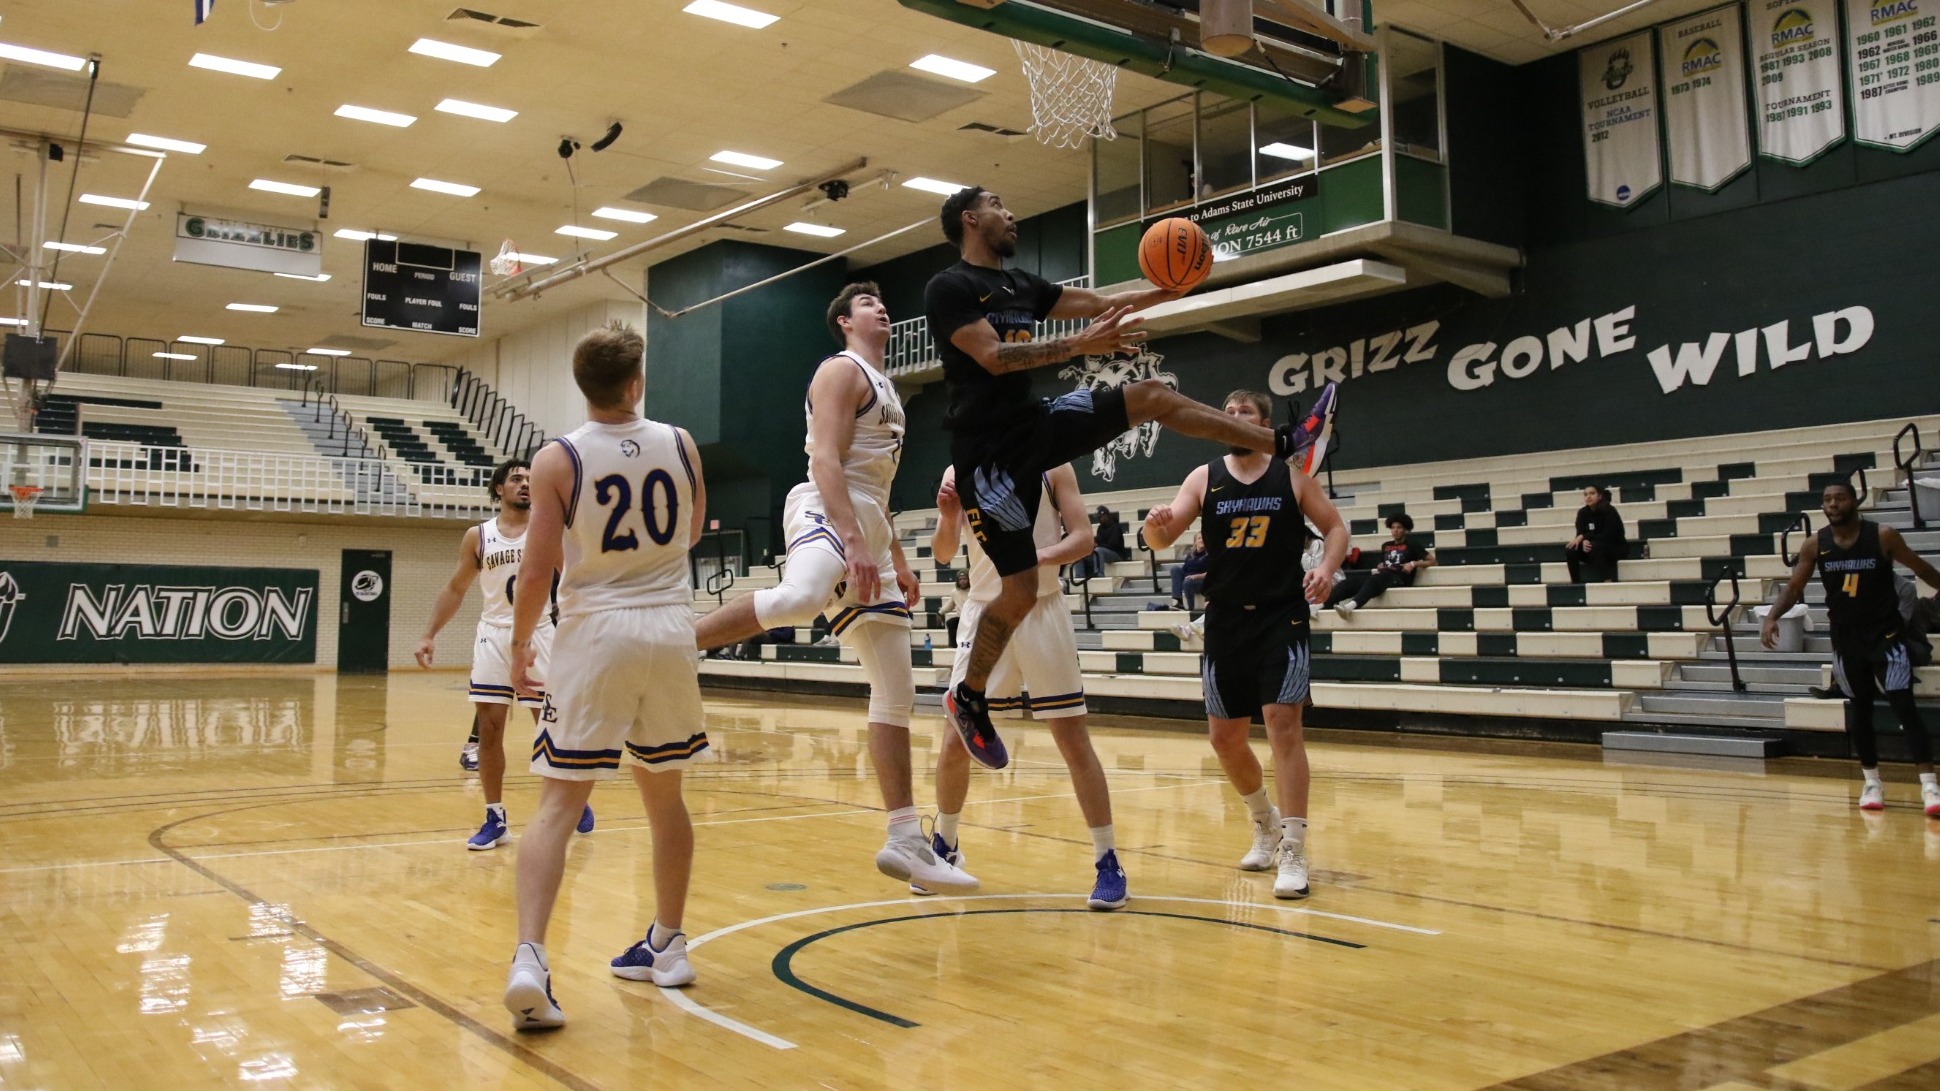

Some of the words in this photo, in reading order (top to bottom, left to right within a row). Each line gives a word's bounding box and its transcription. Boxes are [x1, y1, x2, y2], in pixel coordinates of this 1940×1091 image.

[1871, 0, 1918, 21] RMAC
[1772, 23, 1815, 44] RMAC
[1856, 31, 1880, 45] 1960
[1884, 24, 1907, 38] 1961
[1912, 16, 1936, 31] 1962
[1912, 30, 1938, 45] 1966
[1760, 46, 1795, 61] REGULAR
[1797, 38, 1830, 52] SEASON
[1783, 54, 1805, 66] 1993
[1808, 47, 1832, 61] 2008
[1858, 46, 1880, 59] 1962
[1682, 52, 1721, 73] RMAC
[1858, 59, 1880, 72] 1967
[1885, 51, 1910, 65] 1968
[1887, 65, 1910, 79] 1972
[1915, 58, 1940, 72] 1980
[1916, 72, 1940, 86] 1989
[1587, 86, 1650, 110] VOLLEYBALL
[1766, 90, 1831, 111] TOURNAMENT
[1861, 86, 1882, 100] 1987
[1607, 105, 1631, 118] NCAA
[1786, 106, 1808, 118] 1991
[1811, 100, 1832, 113] 1993
[1588, 108, 1651, 131] TOURNAMENT
[1190, 214, 1199, 222] to
[1201, 204, 1230, 219] Adams
[1231, 198, 1255, 211] State
[1256, 185, 1304, 205] University
[1211, 228, 1222, 241] of
[1225, 223, 1249, 236] Rare
[1246, 229, 1282, 249] 7544
[1285, 225, 1298, 240] ft
[373, 262, 398, 274] HOME
[414, 272, 435, 280] PERIOD
[449, 271, 476, 283] GUEST
[367, 292, 387, 301] FOULS
[405, 297, 427, 306] PLAYER
[427, 299, 443, 308] FOUL
[459, 303, 478, 312] FOULS
[366, 317, 385, 326] SCORE
[412, 321, 433, 330] MATCH
[458, 326, 477, 335] SCORE
[1268, 319, 1440, 396] GRIZZ
[1447, 305, 1637, 390] GONE
[1647, 305, 1875, 395] WILD
[594, 468, 680, 553] 20
[1216, 497, 1282, 515] SKYHAWKS
[1226, 515, 1270, 548] 33
[486, 549, 515, 570] SAVAGE
[1824, 558, 1876, 572] SKYHAWKS
[1842, 573, 1859, 597] 4
[56, 583, 313, 641] NATION
